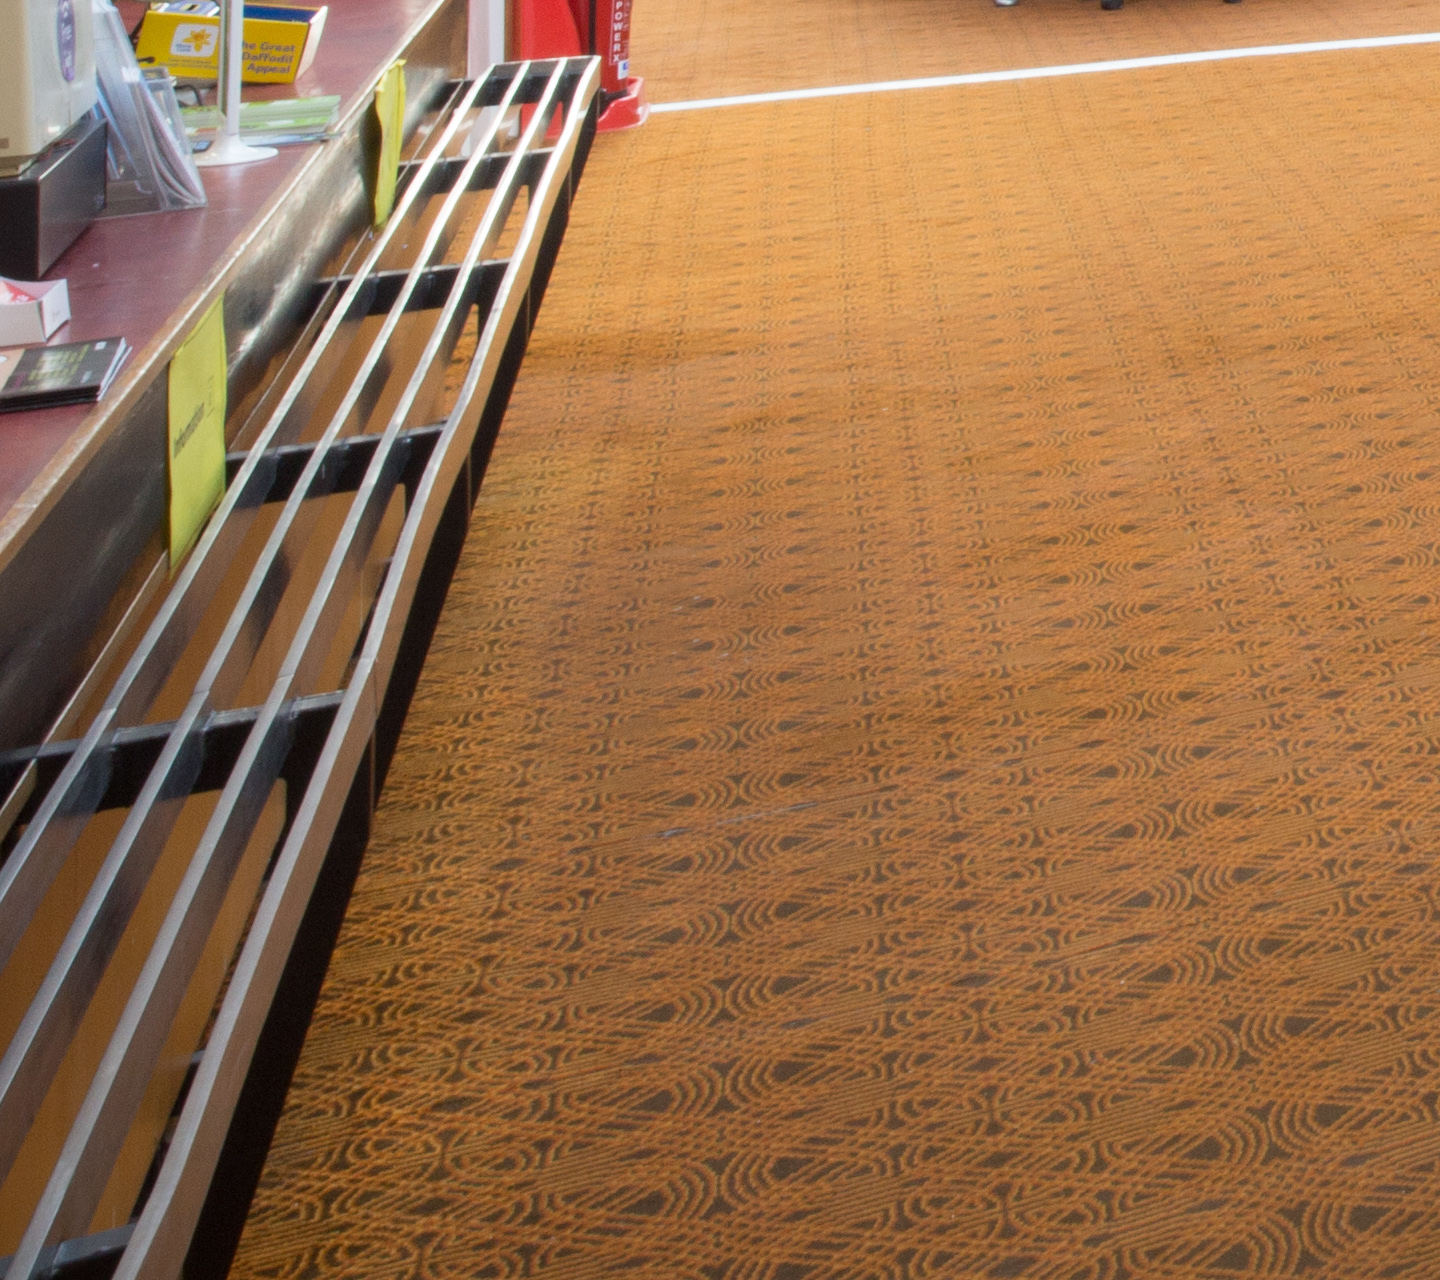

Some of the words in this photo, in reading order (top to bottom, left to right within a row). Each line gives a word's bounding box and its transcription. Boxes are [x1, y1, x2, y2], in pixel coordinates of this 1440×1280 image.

[242, 41, 257, 50] he
[260, 41, 295, 51] Great
[242, 53, 294, 63] Daffodil
[247, 63, 290, 75] Appeal
